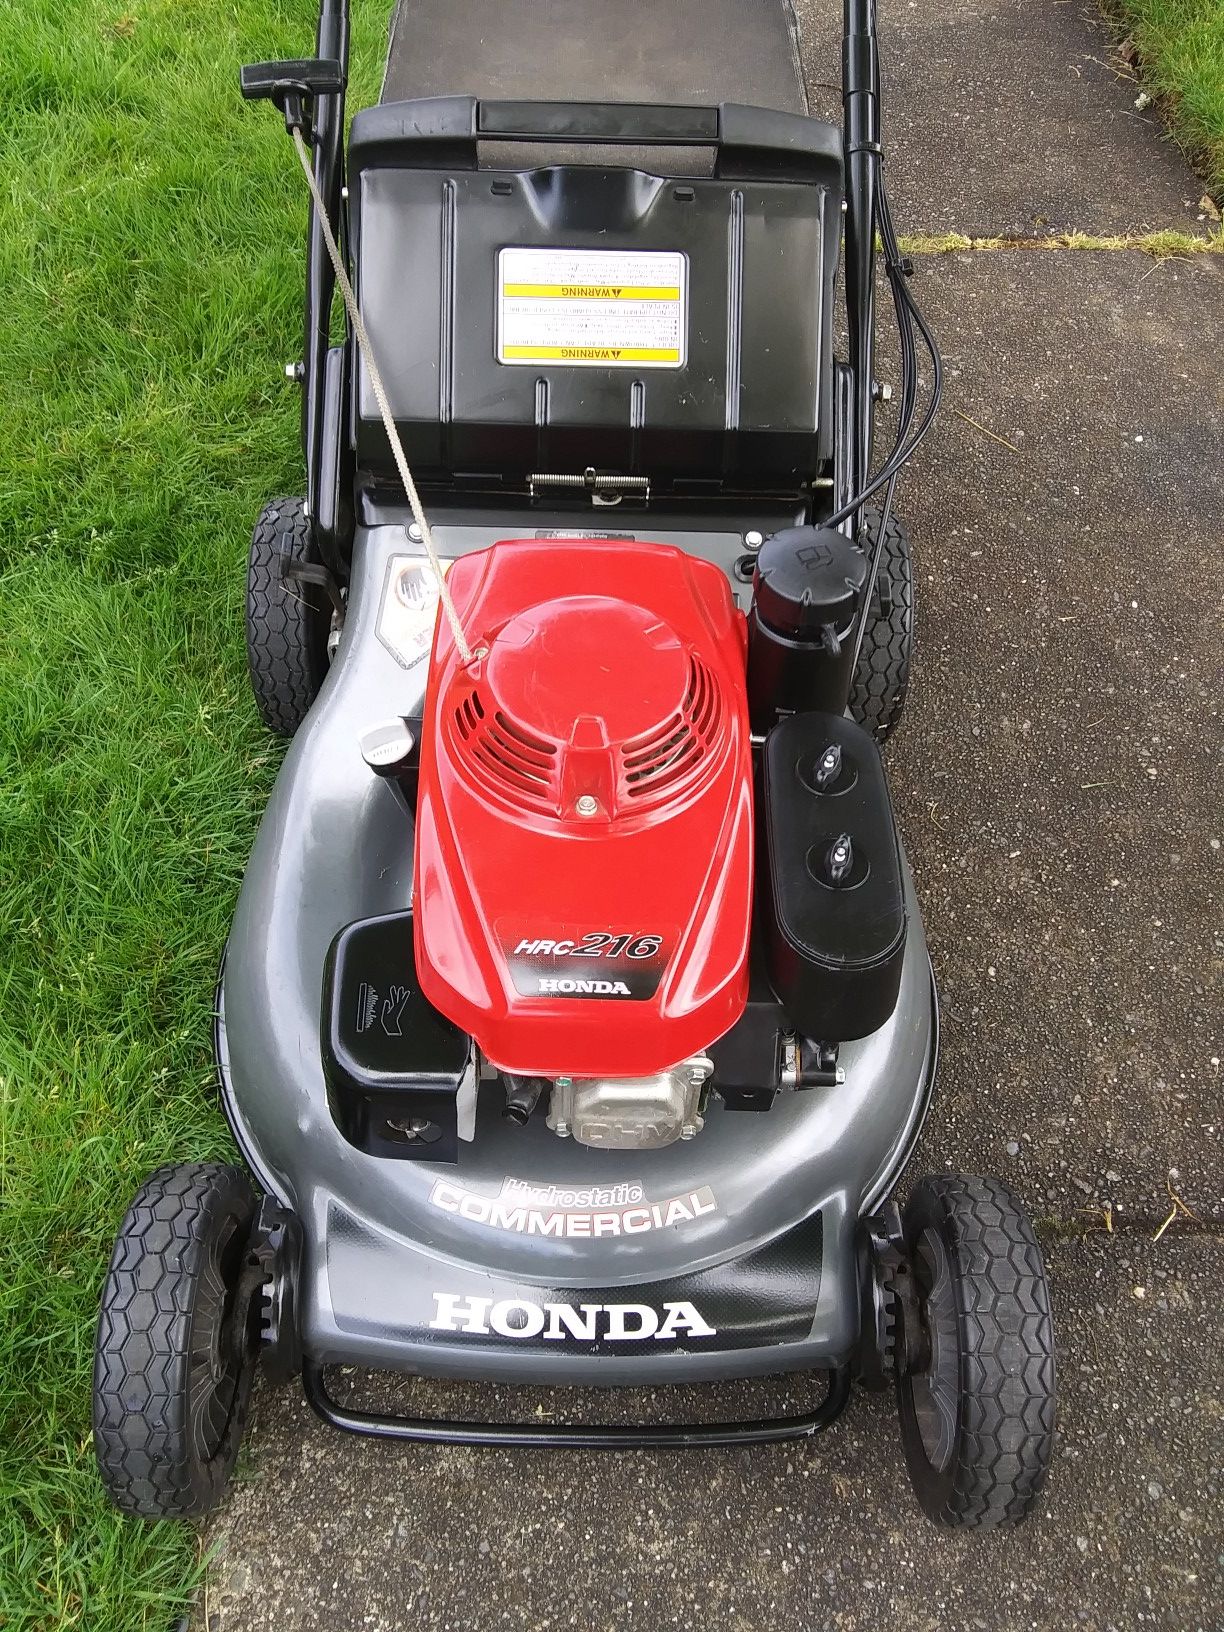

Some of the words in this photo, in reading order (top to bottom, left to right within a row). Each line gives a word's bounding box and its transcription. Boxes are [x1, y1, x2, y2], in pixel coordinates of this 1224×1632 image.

[561, 287, 610, 297] WARNING
[561, 349, 610, 359] WARNING
[538, 978, 632, 995] HONDA
[506, 1179, 643, 1208] Hydrostatic
[432, 1181, 717, 1238] COMMERCIAL
[429, 1292, 717, 1341] HONDA
